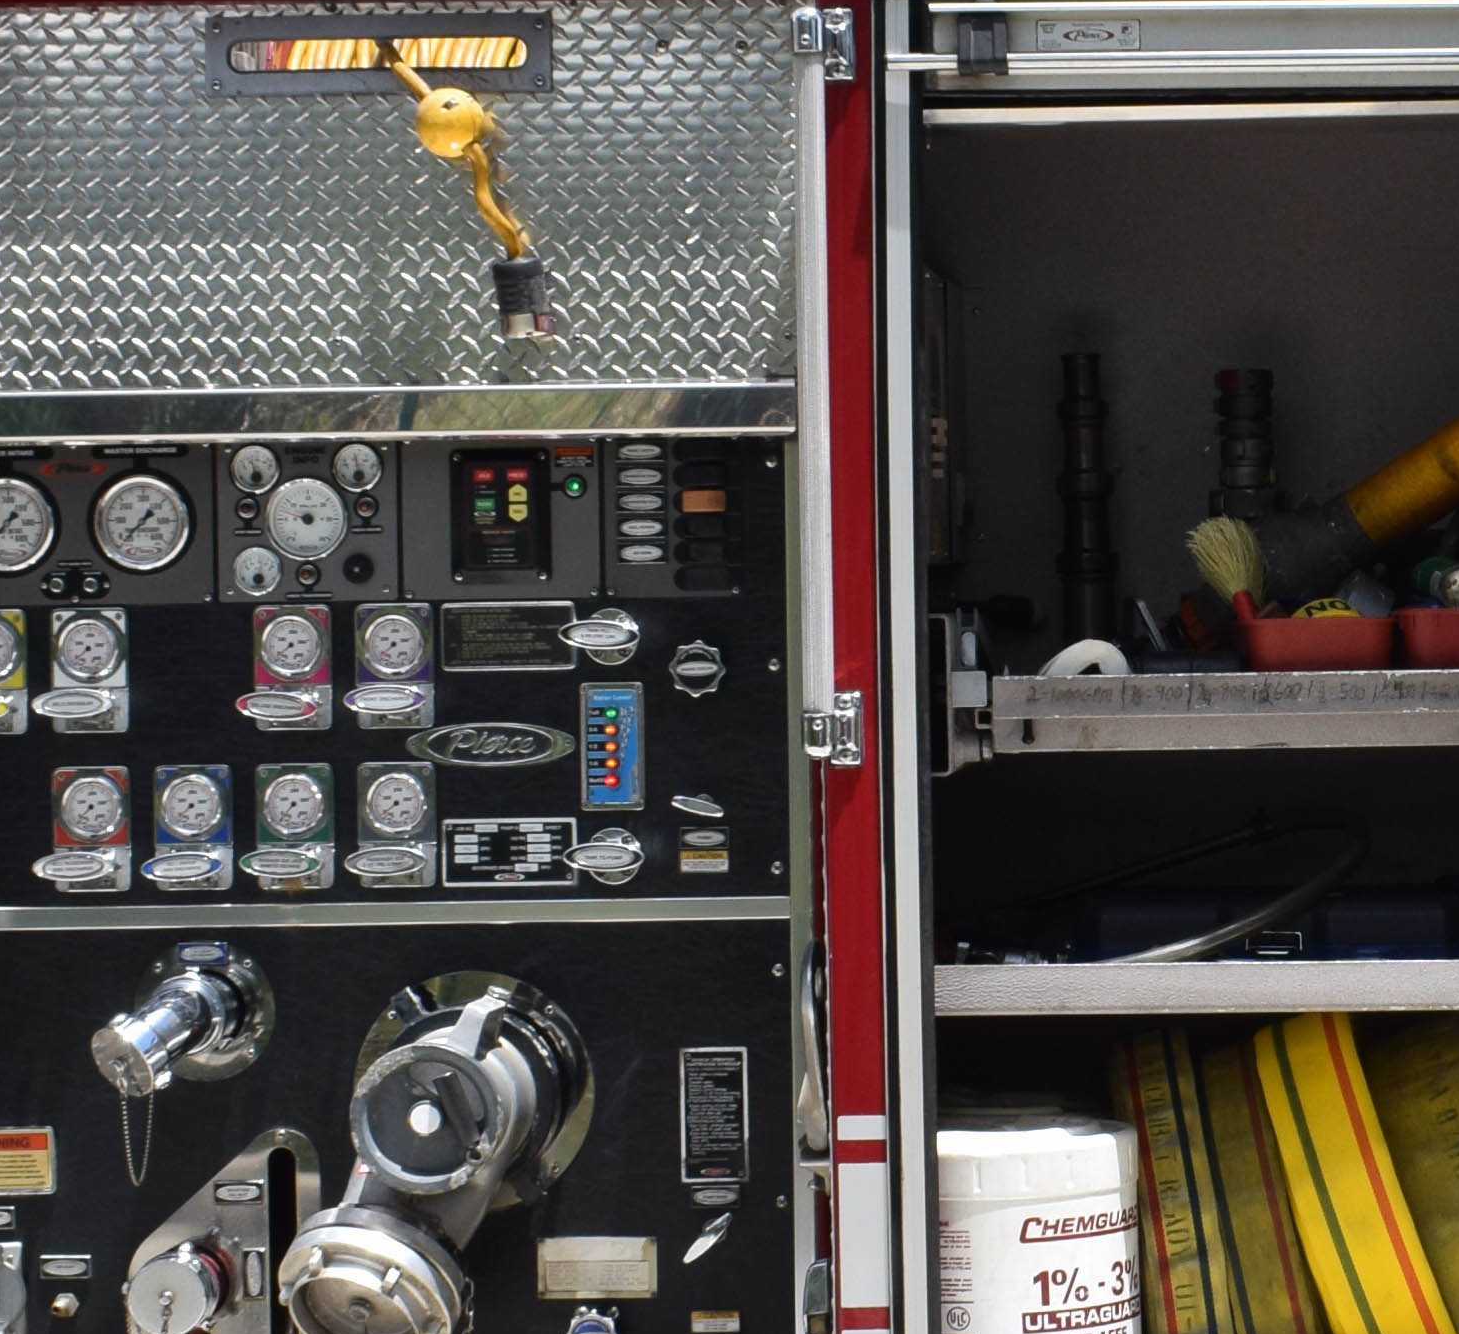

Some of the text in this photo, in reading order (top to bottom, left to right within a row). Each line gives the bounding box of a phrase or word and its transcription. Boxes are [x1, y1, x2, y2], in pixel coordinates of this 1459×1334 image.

[447, 728, 536, 759] Pierce
[1033, 1267, 1089, 1307] 1%
[1111, 1255, 1139, 1296] 3%
